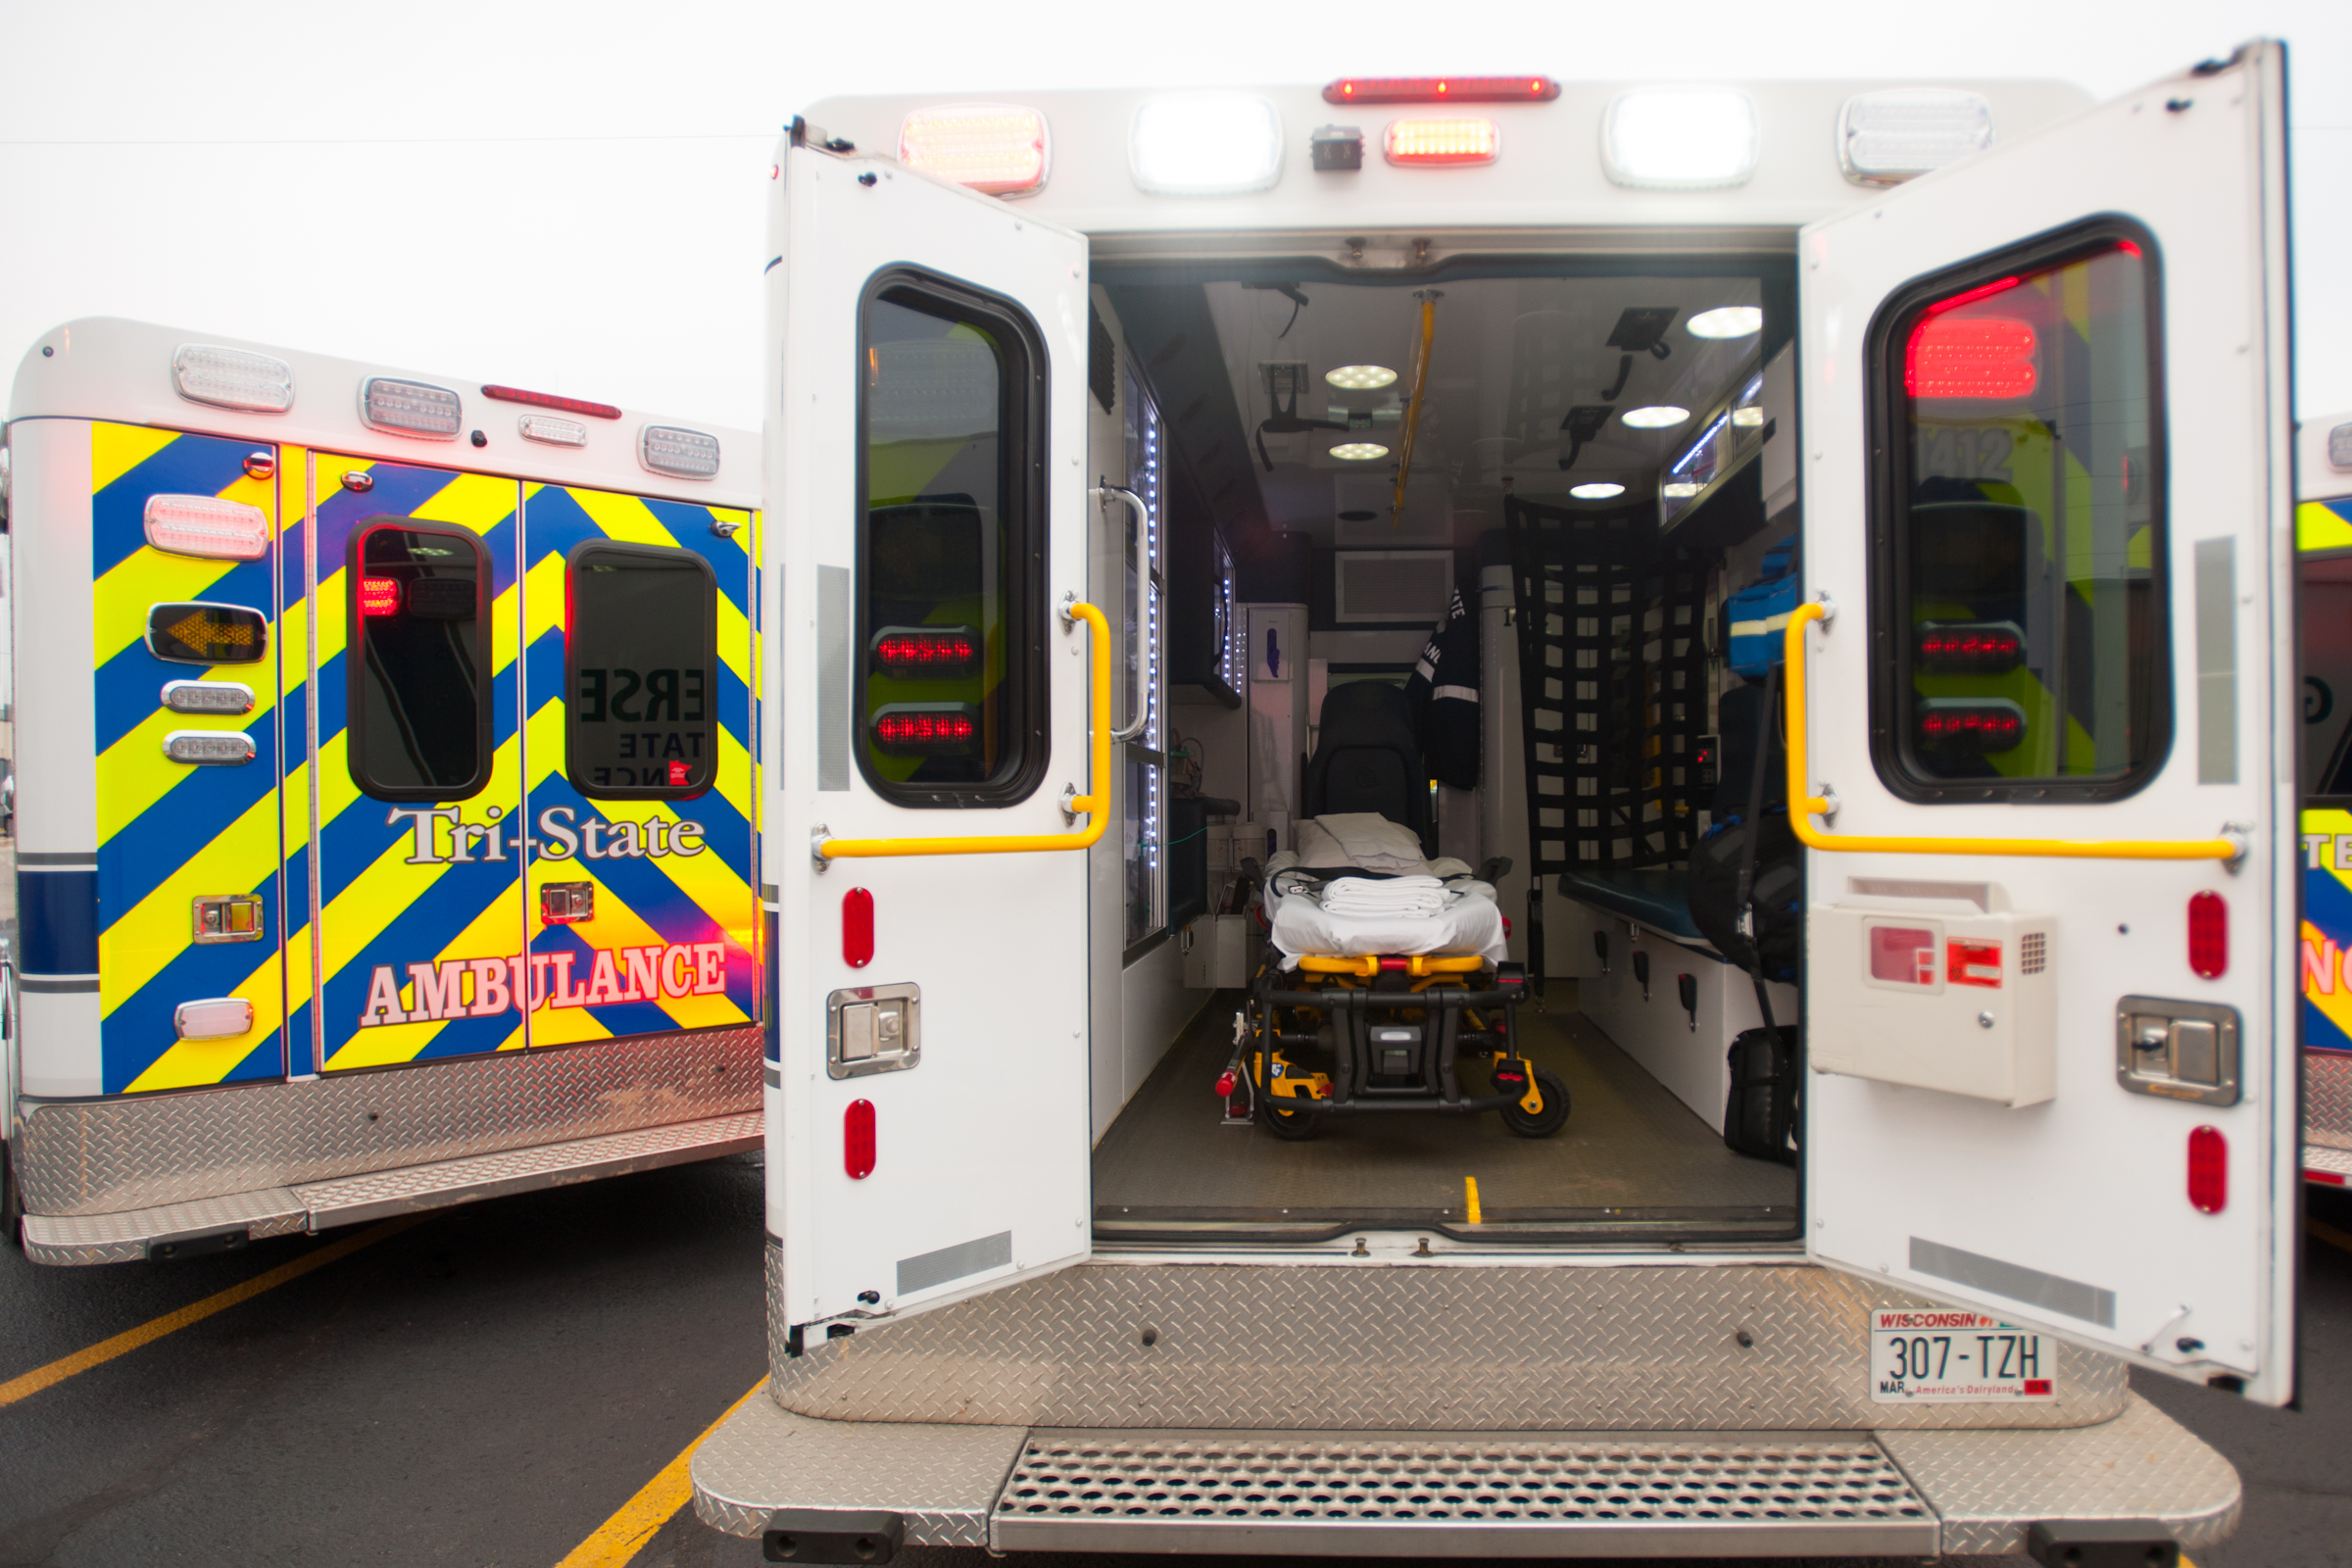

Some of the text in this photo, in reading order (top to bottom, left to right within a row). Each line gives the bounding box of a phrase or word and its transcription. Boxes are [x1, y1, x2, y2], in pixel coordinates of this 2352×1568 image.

[386, 806, 708, 864] Tri-State
[359, 942, 728, 1029] AMBULANCE
[1880, 1313, 1978, 1329] WISCONSIN
[1889, 1335, 2039, 1380] 307-TZH
[1880, 1381, 1905, 1395] MAR
[1915, 1384, 2014, 1396] America's Dairyland
